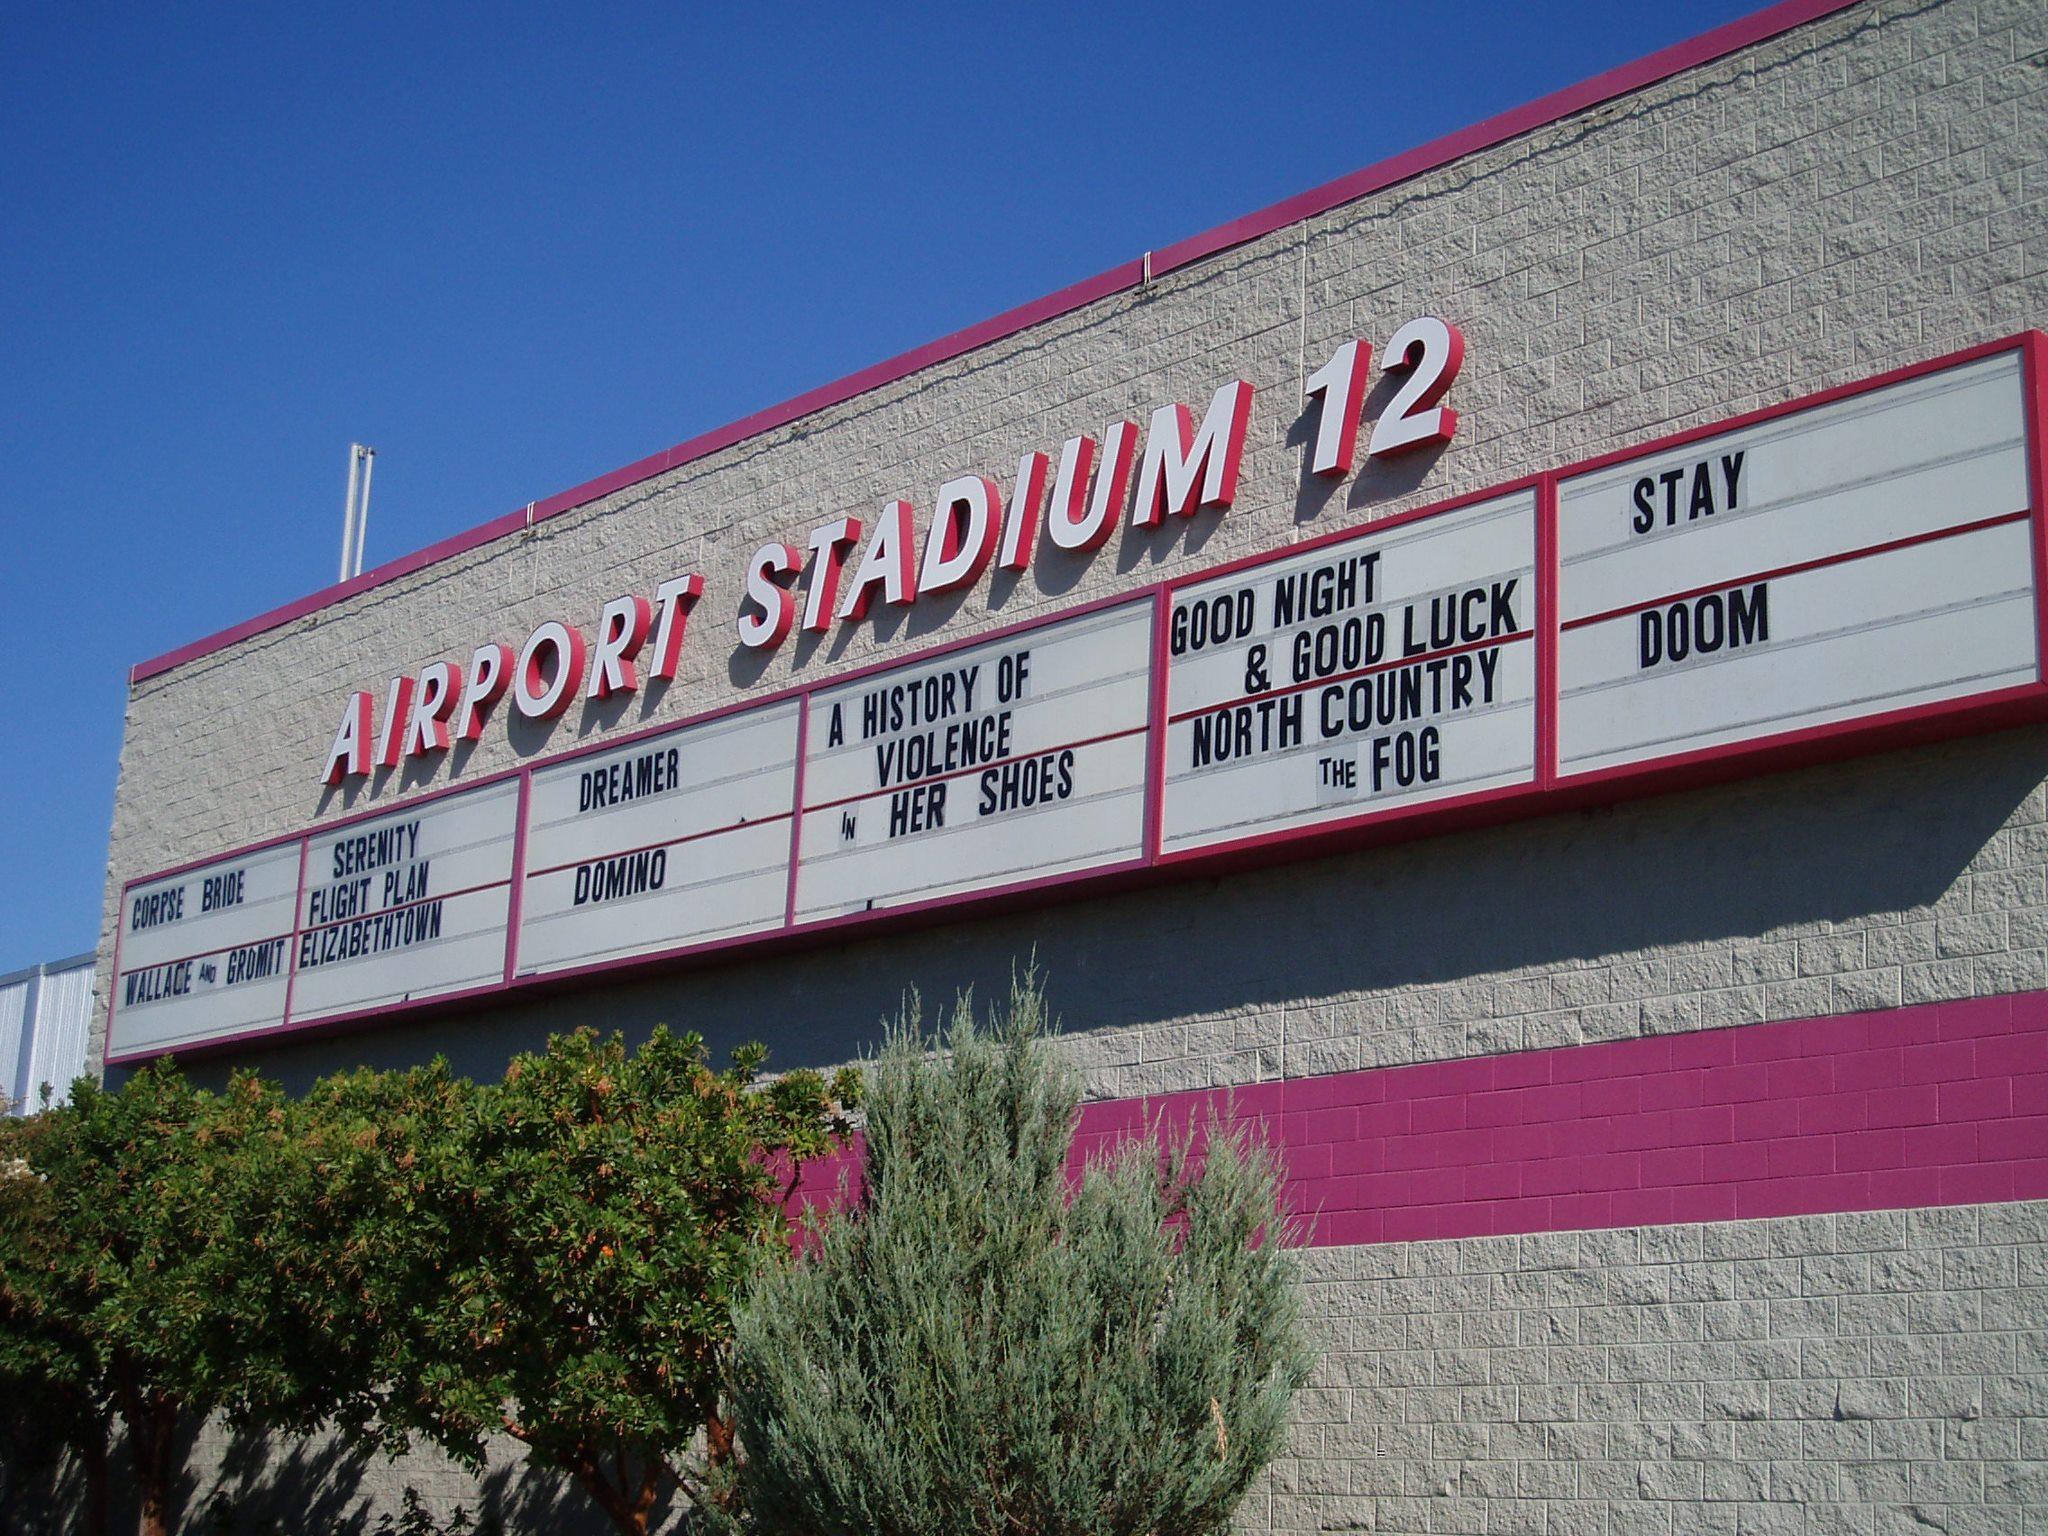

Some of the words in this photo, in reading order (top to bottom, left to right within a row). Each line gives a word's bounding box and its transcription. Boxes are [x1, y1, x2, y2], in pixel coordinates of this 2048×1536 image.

[1633, 452, 1744, 533] STAY
[320, 573, 705, 786] AIRPORT
[738, 379, 1254, 651] STADIUM
[1306, 316, 1464, 476] 12
[1170, 589, 1254, 656] GOOD
[1274, 551, 1380, 628] NIGHT
[1245, 644, 1271, 694] &
[1293, 613, 1385, 682] GOOD
[1403, 579, 1519, 657] LUCK
[1640, 583, 1768, 668] DOOM
[828, 704, 843, 748] A
[863, 666, 978, 738] HISTORY
[998, 651, 1029, 703] OF
[1193, 695, 1301, 767] NORTH
[1321, 647, 1498, 737] COUNTRY
[579, 748, 679, 812] DREAMER
[876, 712, 1011, 788] VIOLENCE
[1320, 756, 1356, 789] THE
[1373, 726, 1439, 792] FOG
[841, 811, 855, 840] IN
[890, 783, 945, 837] HER
[979, 751, 1073, 816] SHOES
[333, 820, 420, 878] SERENITY
[574, 849, 666, 905] DOMINO
[132, 887, 185, 930] CORPSE
[202, 870, 245, 912] BRIDE
[309, 877, 371, 926] FLIGHT
[383, 861, 429, 905] PLAN
[300, 901, 442, 968] ELIZABETHTOWN
[125, 961, 192, 1006] WALLACE
[199, 964, 216, 984] AND
[227, 940, 285, 984] GROMIT
